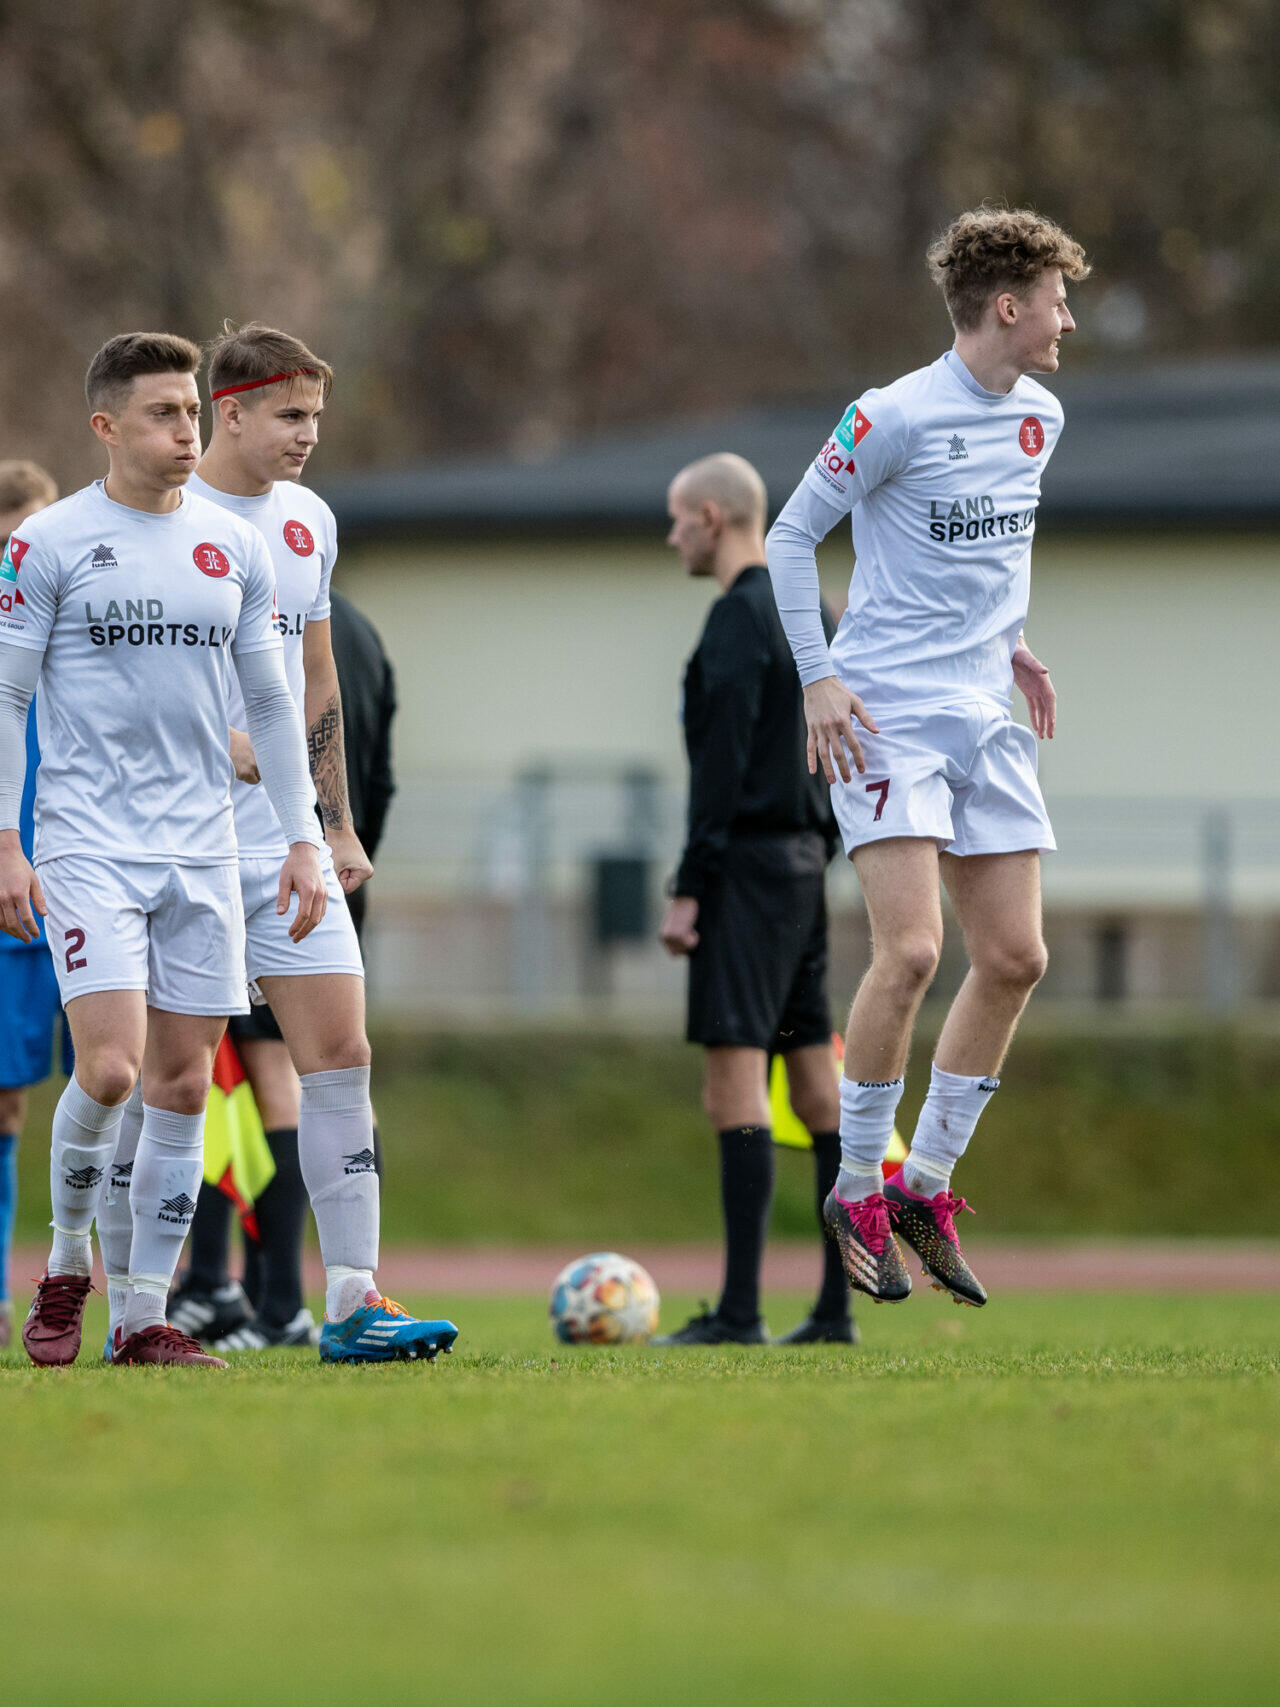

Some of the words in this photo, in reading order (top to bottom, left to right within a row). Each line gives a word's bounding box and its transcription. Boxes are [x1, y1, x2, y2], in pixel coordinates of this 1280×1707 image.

[929, 494, 995, 521] LAND
[92, 559, 118, 569] luanvi
[85, 599, 165, 624] LAND
[89, 623, 232, 648] SPORTS.LV
[865, 778, 890, 822] 7
[64, 928, 87, 974] 2
